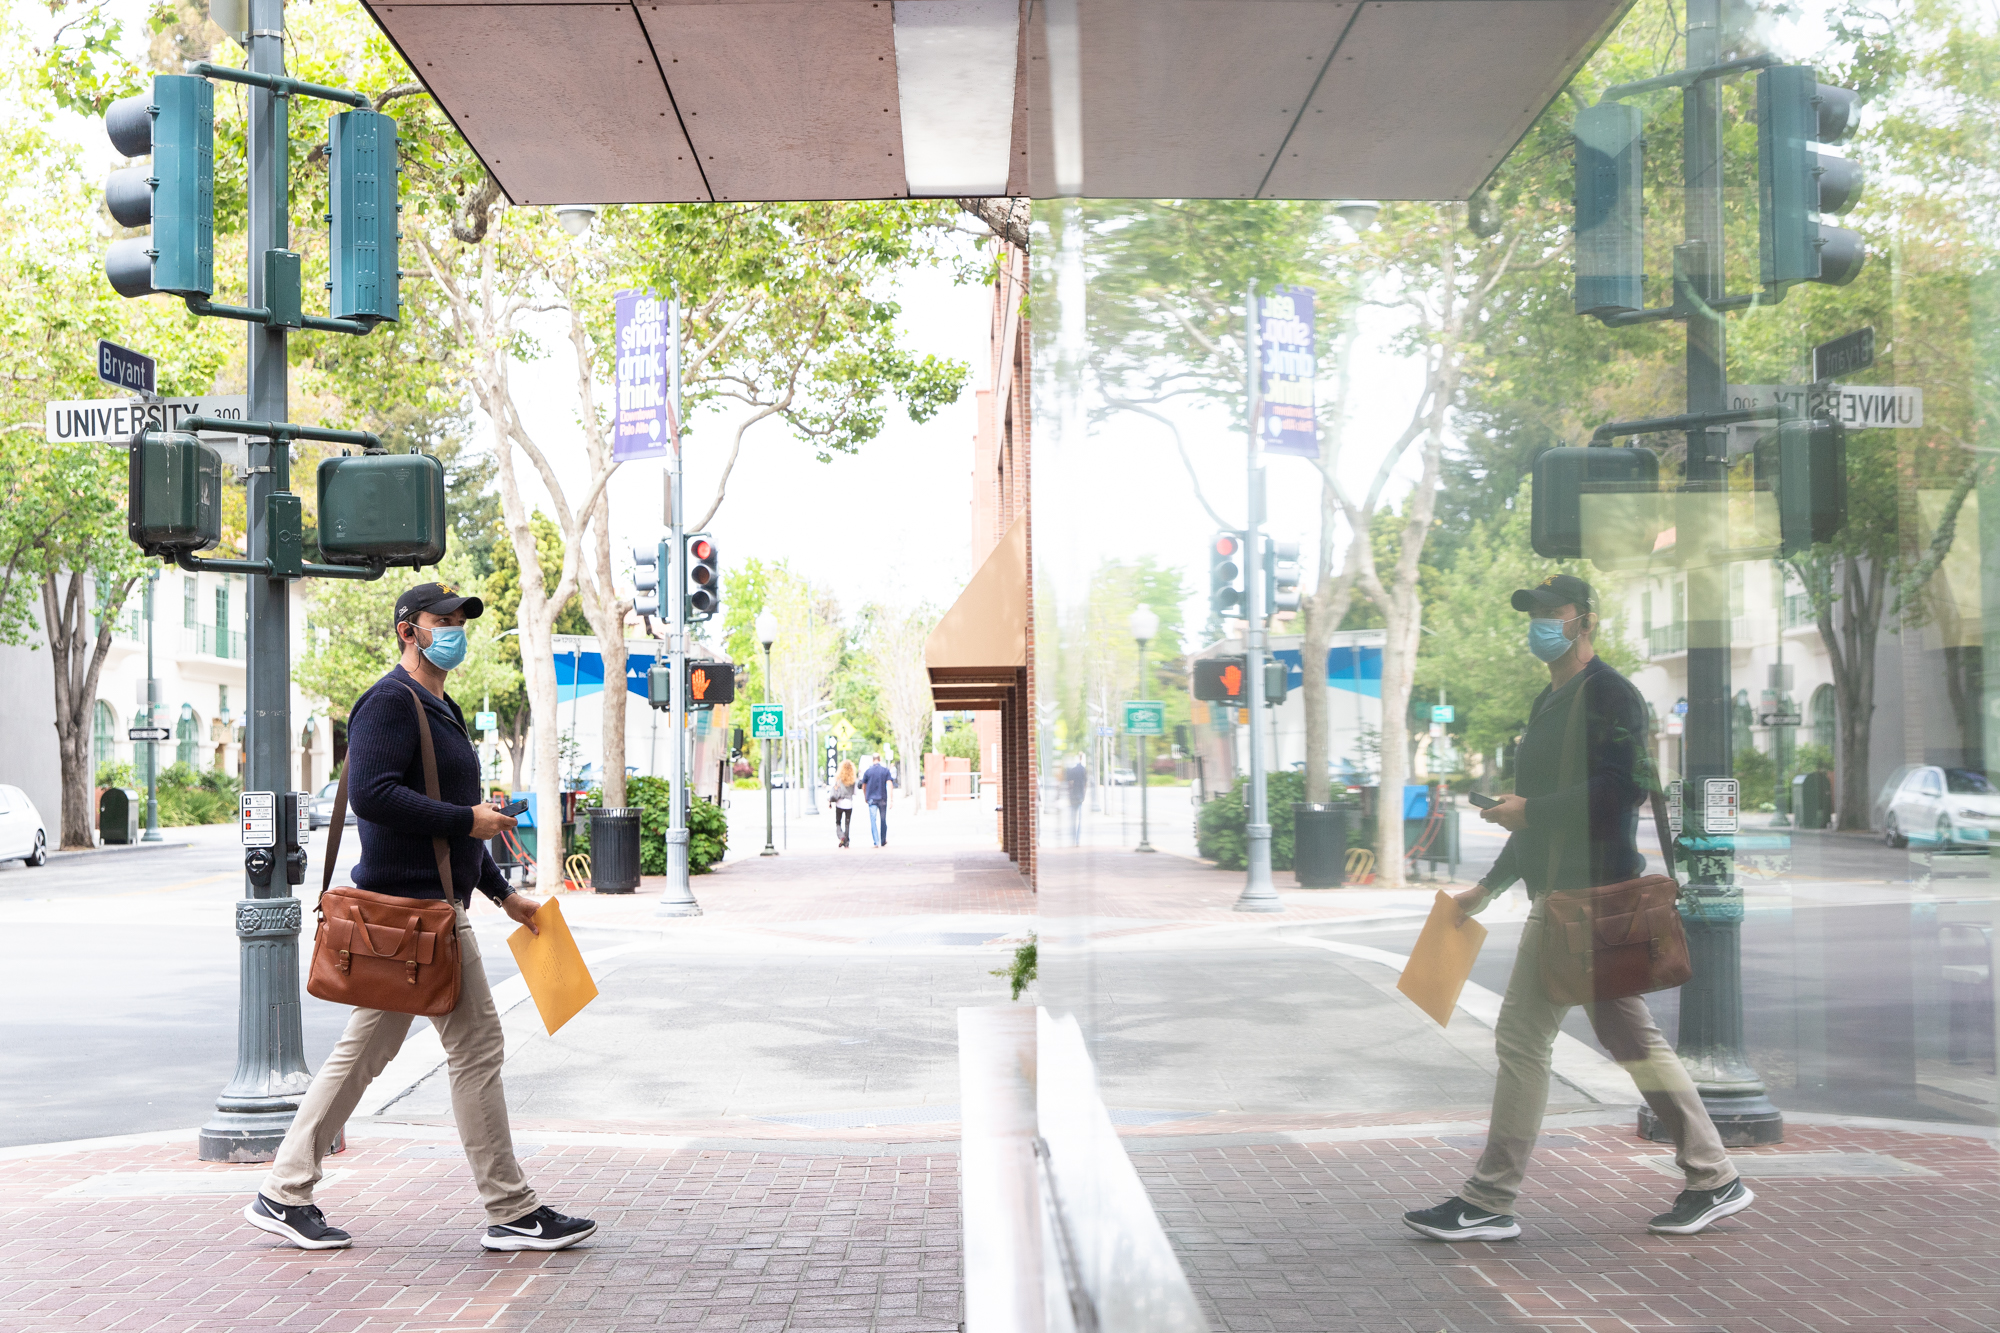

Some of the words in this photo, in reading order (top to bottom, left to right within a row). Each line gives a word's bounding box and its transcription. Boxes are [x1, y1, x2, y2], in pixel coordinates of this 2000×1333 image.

[621, 318, 664, 352] shop.
[103, 347, 146, 387] Bryant
[618, 347, 664, 381] drink.
[618, 377, 664, 411] think.
[214, 408, 241, 420] 300
[620, 408, 657, 423] Downtown
